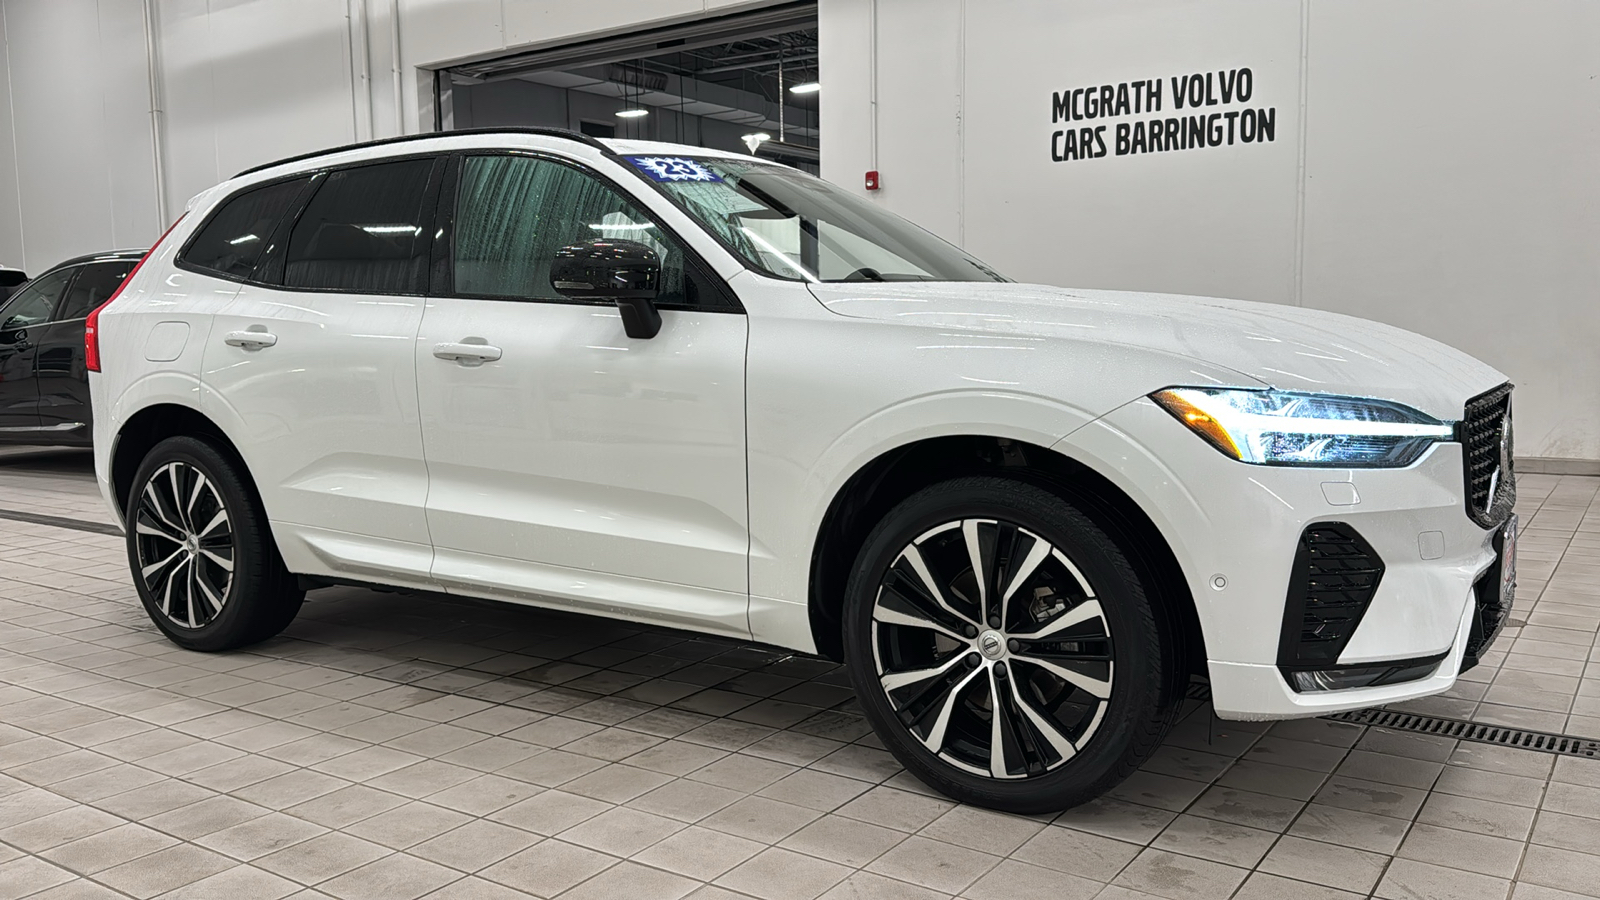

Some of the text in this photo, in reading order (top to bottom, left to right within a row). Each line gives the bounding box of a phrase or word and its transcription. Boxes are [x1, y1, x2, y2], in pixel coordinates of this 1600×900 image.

[1052, 67, 1253, 124] MCGRATH VOLVO
[1051, 107, 1276, 163] CARS BARRINGTON
[655, 160, 698, 176] 23
